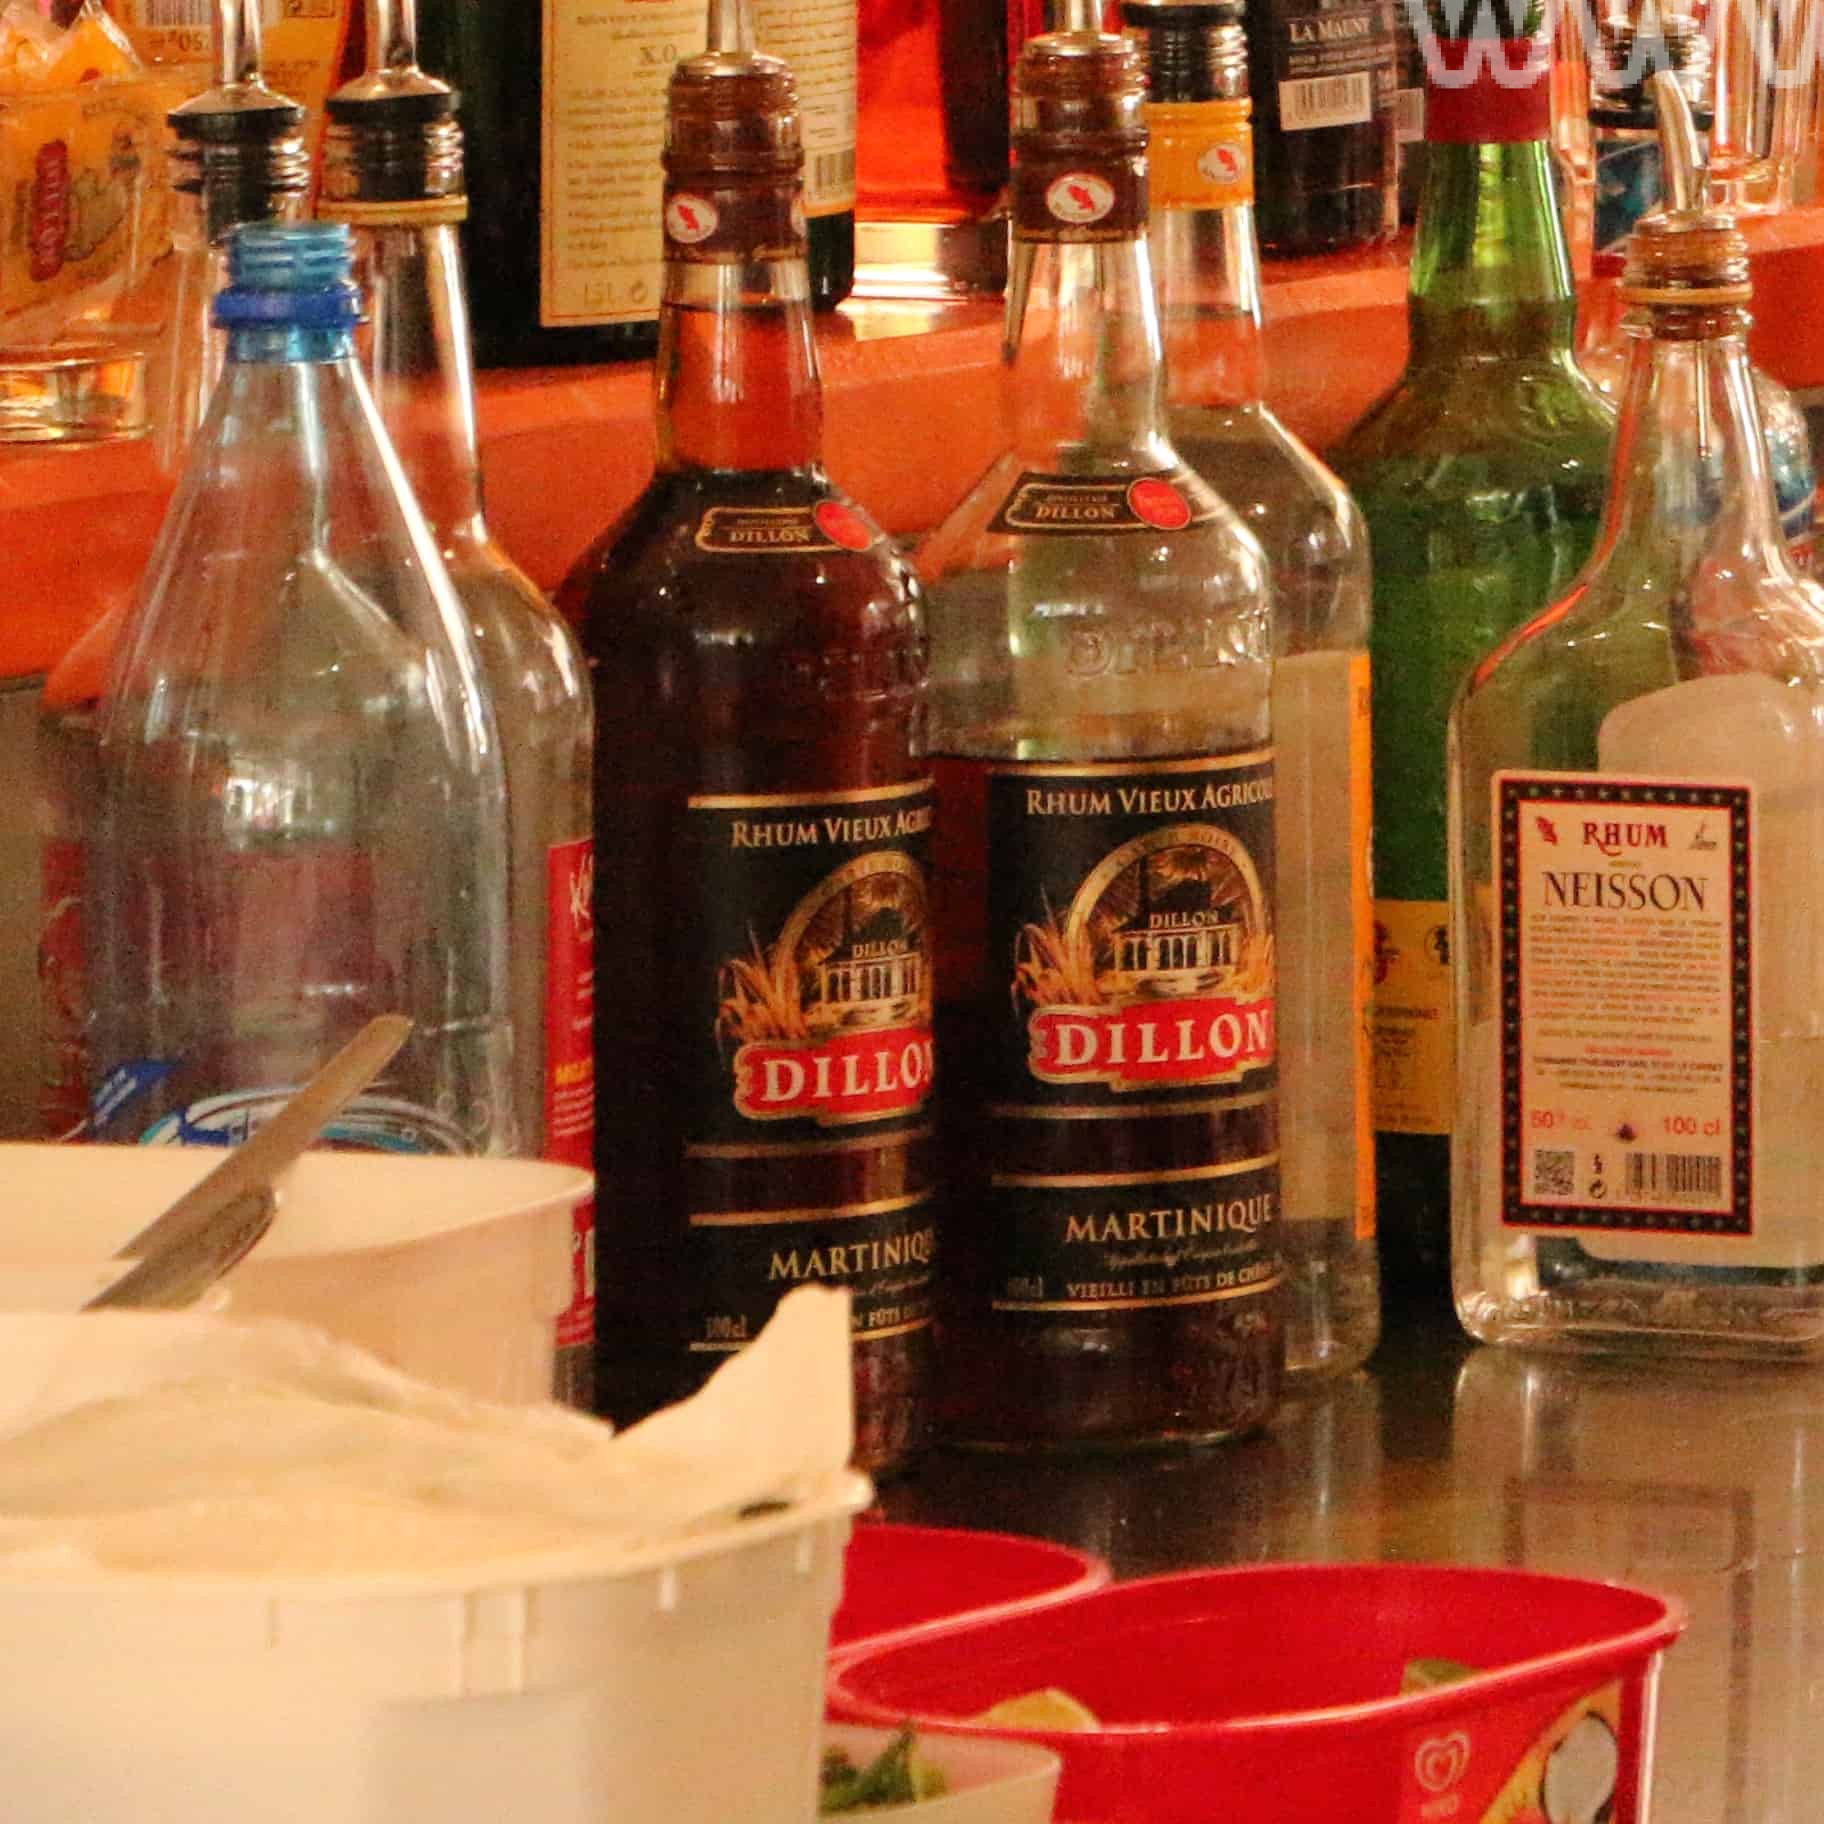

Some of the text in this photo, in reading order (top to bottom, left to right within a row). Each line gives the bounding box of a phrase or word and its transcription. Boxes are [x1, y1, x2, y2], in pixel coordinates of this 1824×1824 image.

[1035, 505, 1118, 520] DILLON
[729, 528, 810, 544] DILLON
[1027, 776, 1273, 816] RHUM VIEUX AGRICOL
[731, 820, 818, 849] RHUM
[824, 815, 893, 845] VIEUX
[1582, 822, 1669, 857] RHUM
[1541, 871, 1710, 912] NEISSON
[1150, 910, 1219, 930] DILLON
[1053, 1009, 1269, 1066] DILLON
[1065, 1193, 1272, 1243] MARTINIQUE
[768, 1228, 934, 1281] MARTINIQ
